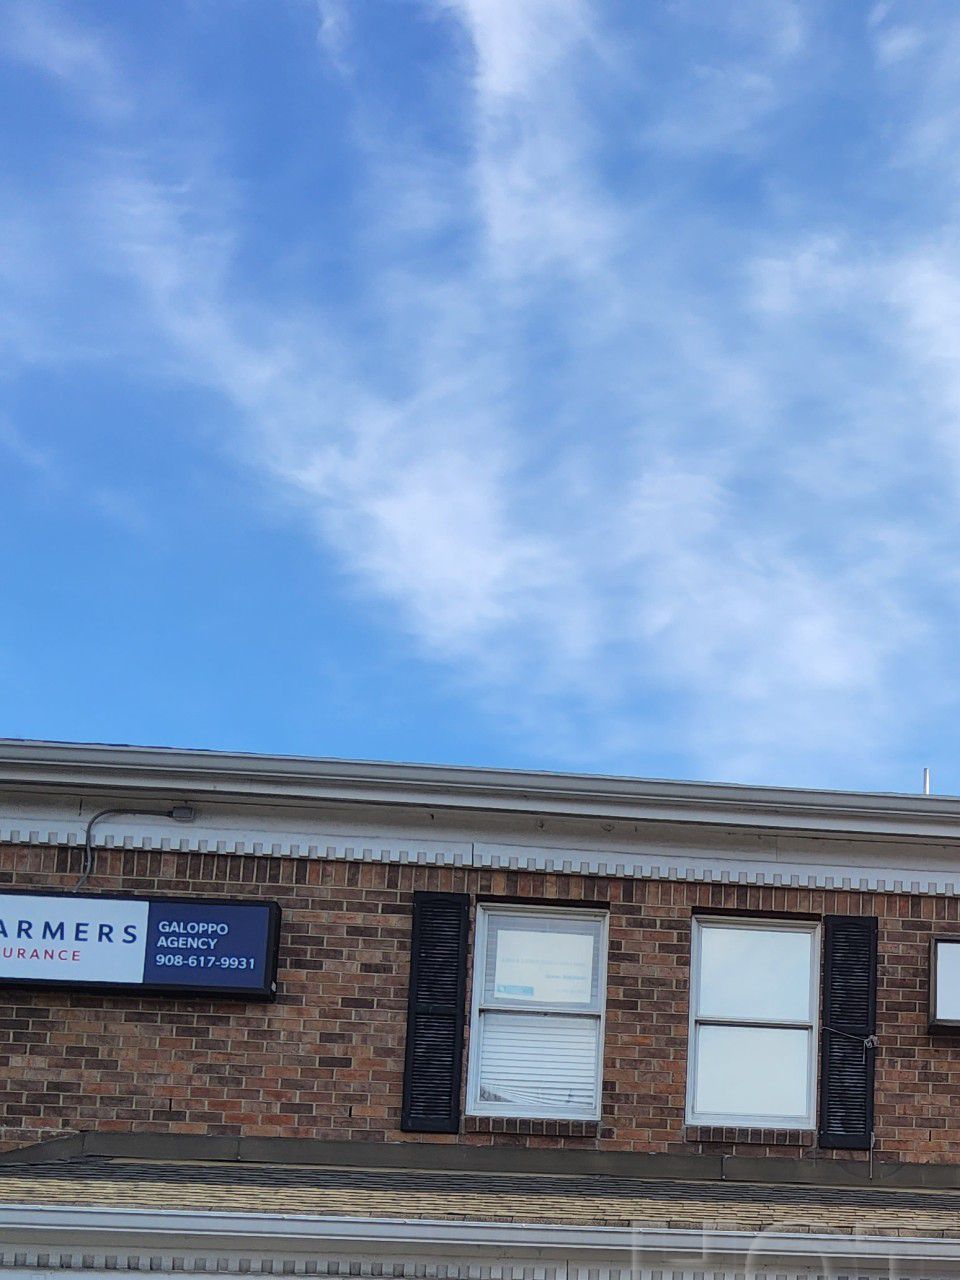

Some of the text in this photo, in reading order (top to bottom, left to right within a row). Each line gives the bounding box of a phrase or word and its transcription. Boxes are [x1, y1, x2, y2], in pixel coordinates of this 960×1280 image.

[158, 921, 229, 936] GALOPPO
[157, 937, 218, 950] AGENCY
[156, 954, 256, 970] 908-617-9931
